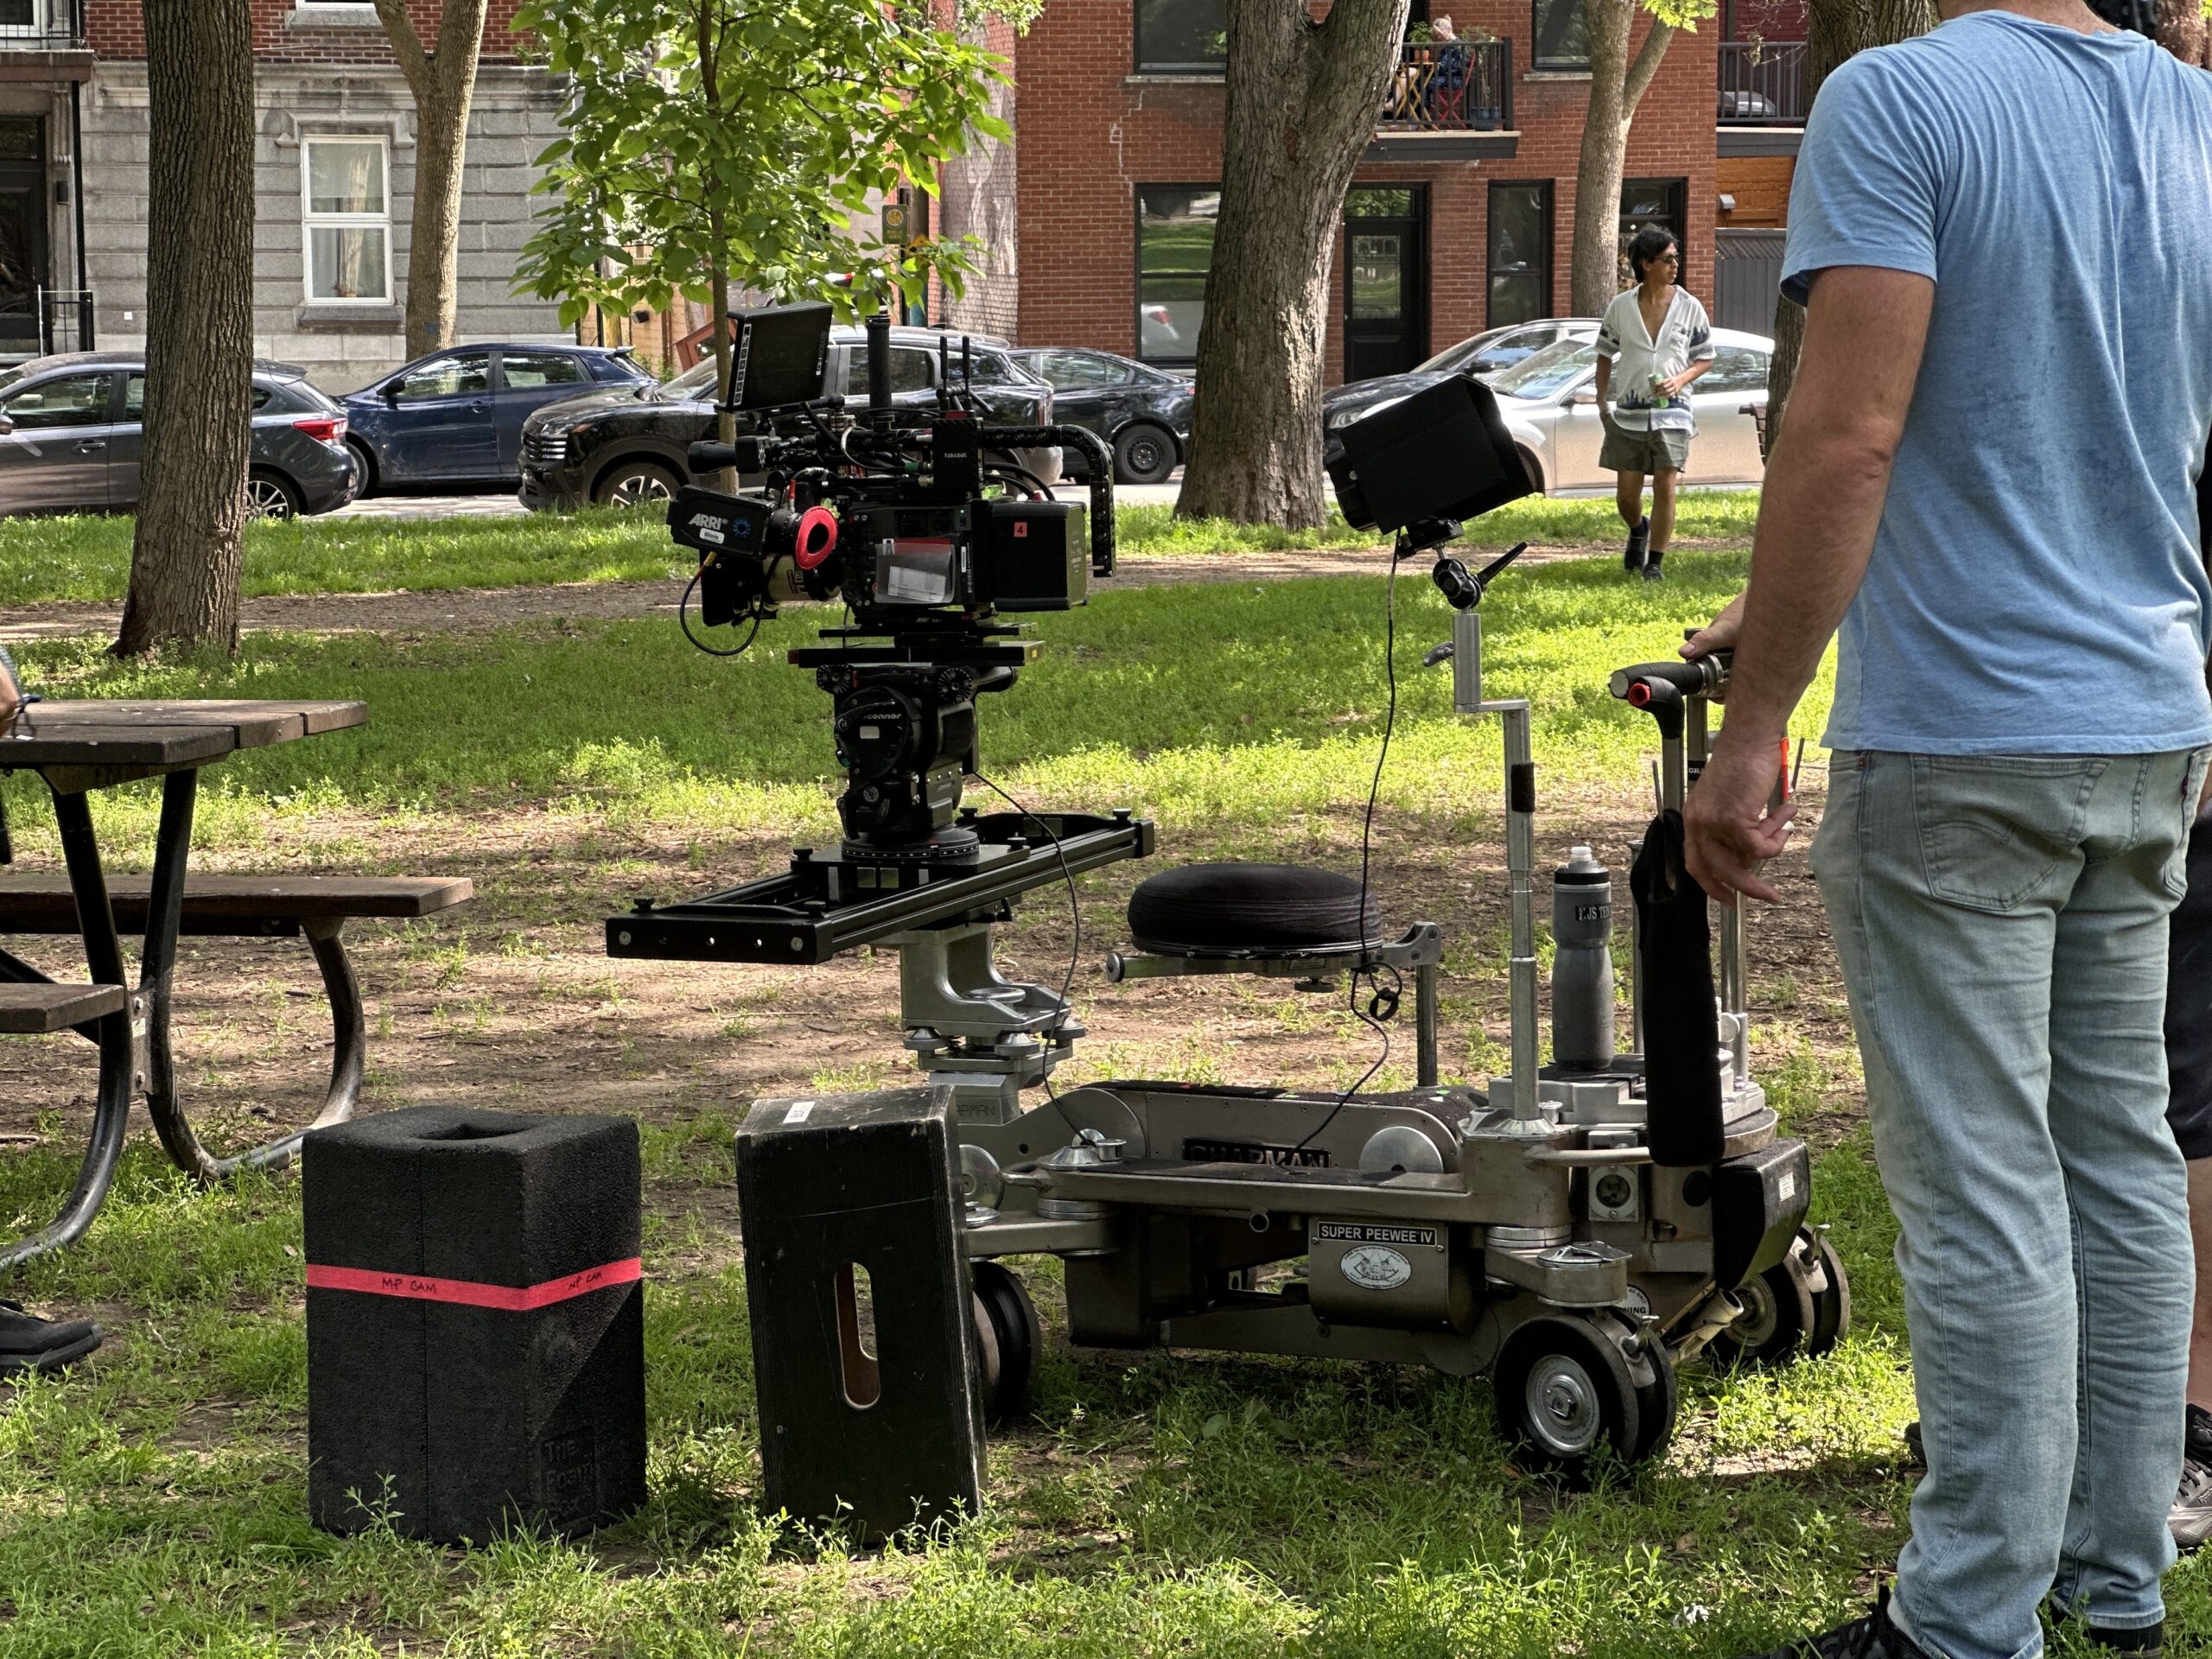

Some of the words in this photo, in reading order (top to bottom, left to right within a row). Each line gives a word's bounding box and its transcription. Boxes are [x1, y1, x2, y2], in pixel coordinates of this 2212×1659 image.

[688, 513, 722, 531] ARRI
[1017, 525, 1024, 534] 4
[956, 1104, 995, 1117] APMAN
[1321, 1225, 1362, 1240] SUPER
[1366, 1228, 1417, 1243] PEEWEE
[1421, 1231, 1433, 1243] IV
[381, 1278, 403, 1291] MP
[410, 1280, 436, 1294] CAM
[568, 1277, 582, 1290] MP
[586, 1272, 602, 1284] CAM
